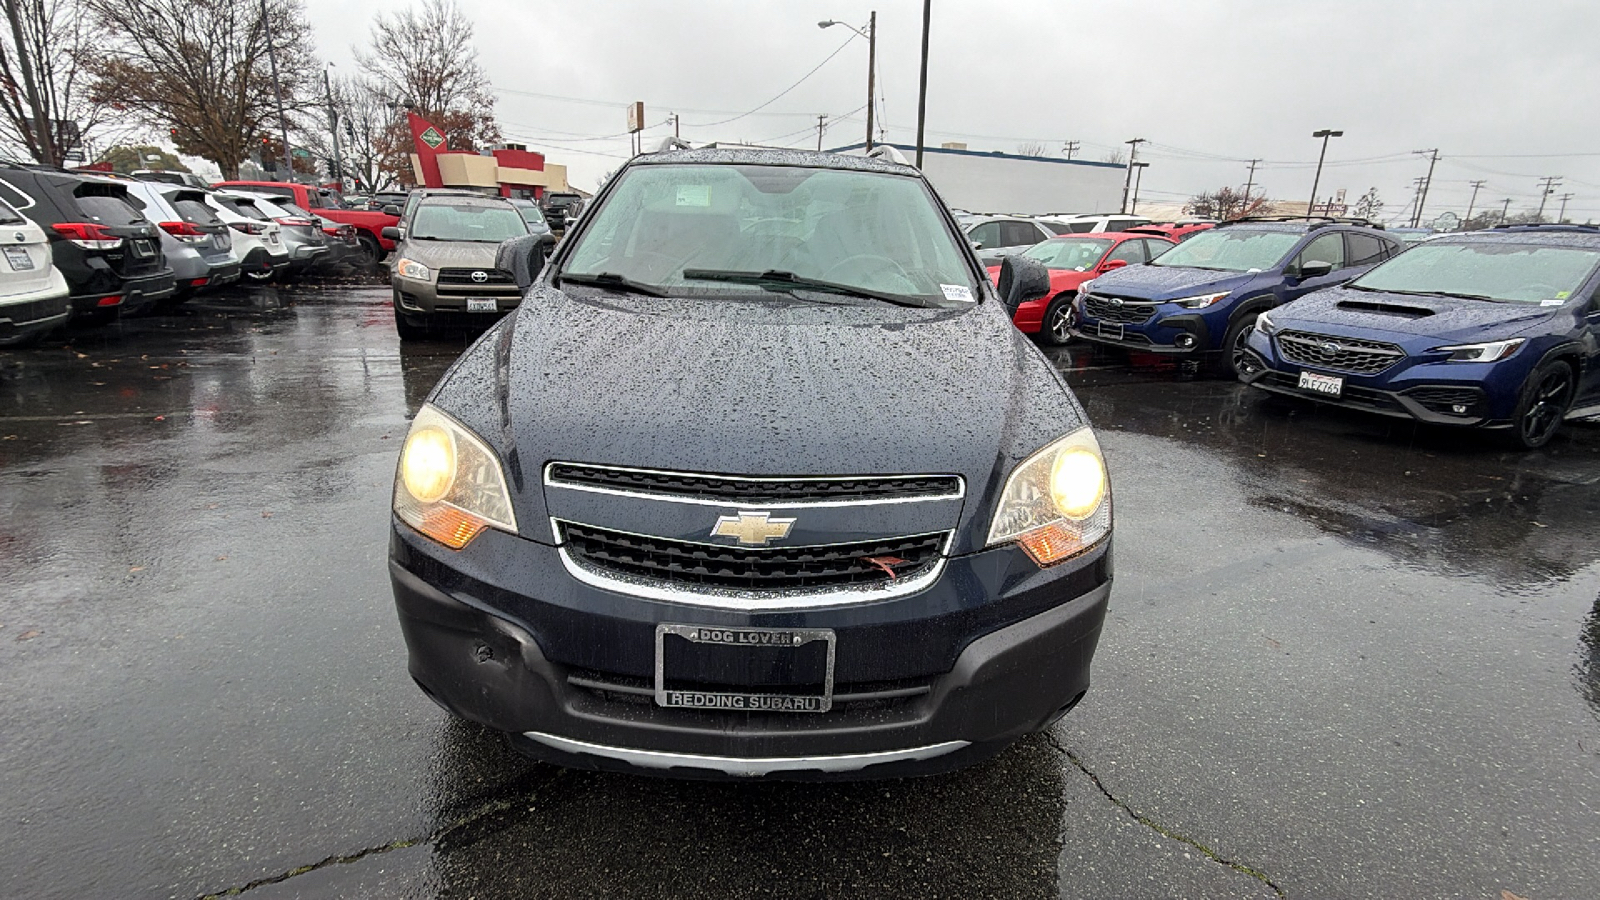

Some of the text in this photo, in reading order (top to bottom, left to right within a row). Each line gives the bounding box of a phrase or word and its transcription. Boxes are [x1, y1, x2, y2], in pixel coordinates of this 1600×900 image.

[700, 629, 792, 644] DOG LOVER
[671, 693, 816, 710] REDDING SUBARU
